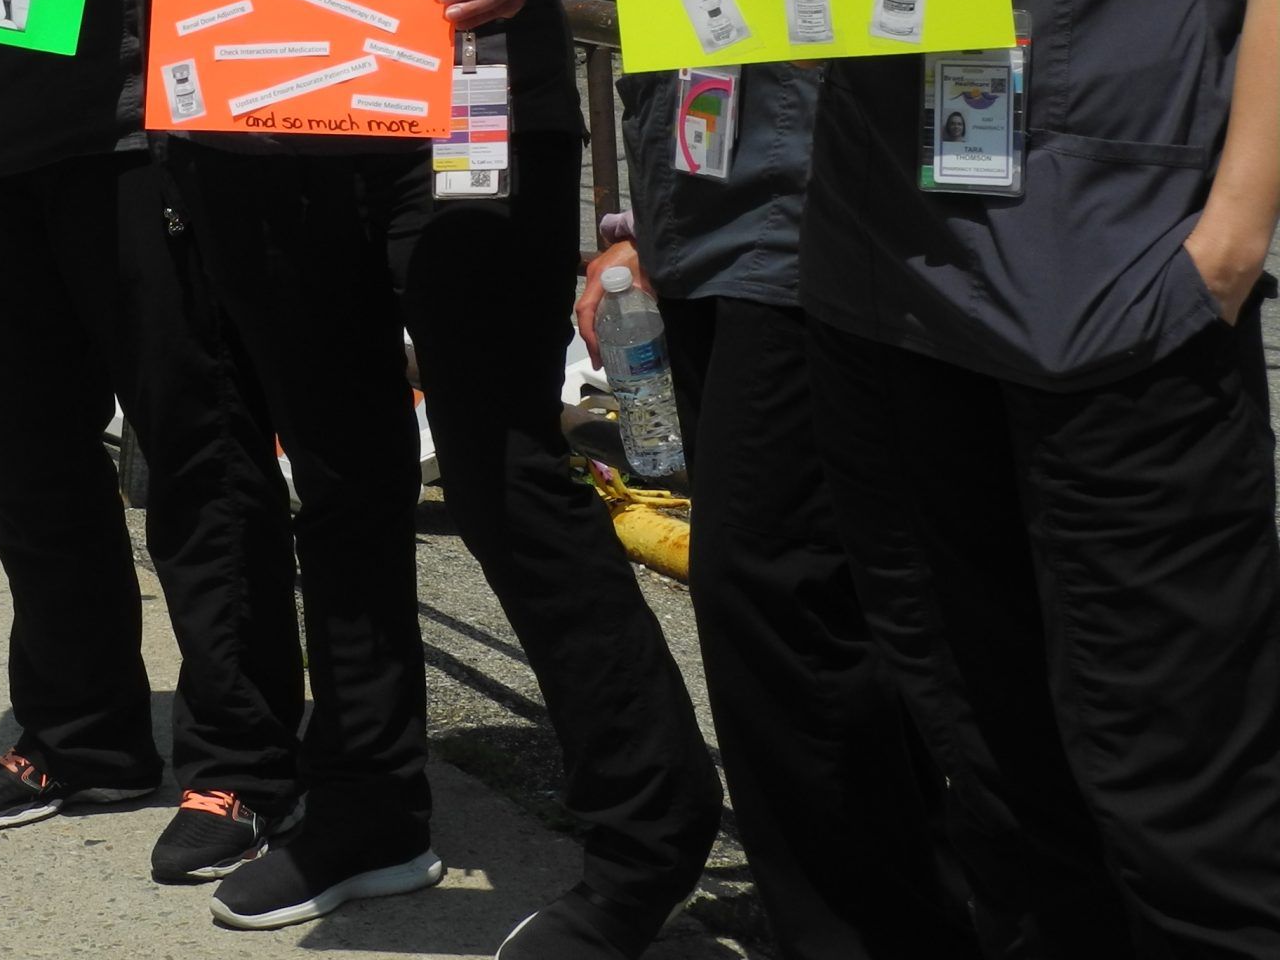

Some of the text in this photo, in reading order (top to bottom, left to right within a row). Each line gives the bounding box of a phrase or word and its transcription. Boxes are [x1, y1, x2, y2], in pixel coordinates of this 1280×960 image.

[182, 5, 246, 31] Renal Dose Adjusting
[378, 16, 393, 28] Bags
[220, 45, 328, 56] Check Interactions of Medications
[369, 43, 436, 68] Monitor Medications
[236, 93, 260, 109] Update
[260, 90, 272, 101] and
[273, 85, 294, 97] Ensure
[295, 76, 324, 89] Accurate
[324, 68, 351, 81] Patients
[357, 98, 424, 113] Provide Medications
[246, 112, 276, 128] and
[283, 117, 302, 128] so
[308, 113, 360, 131] much
